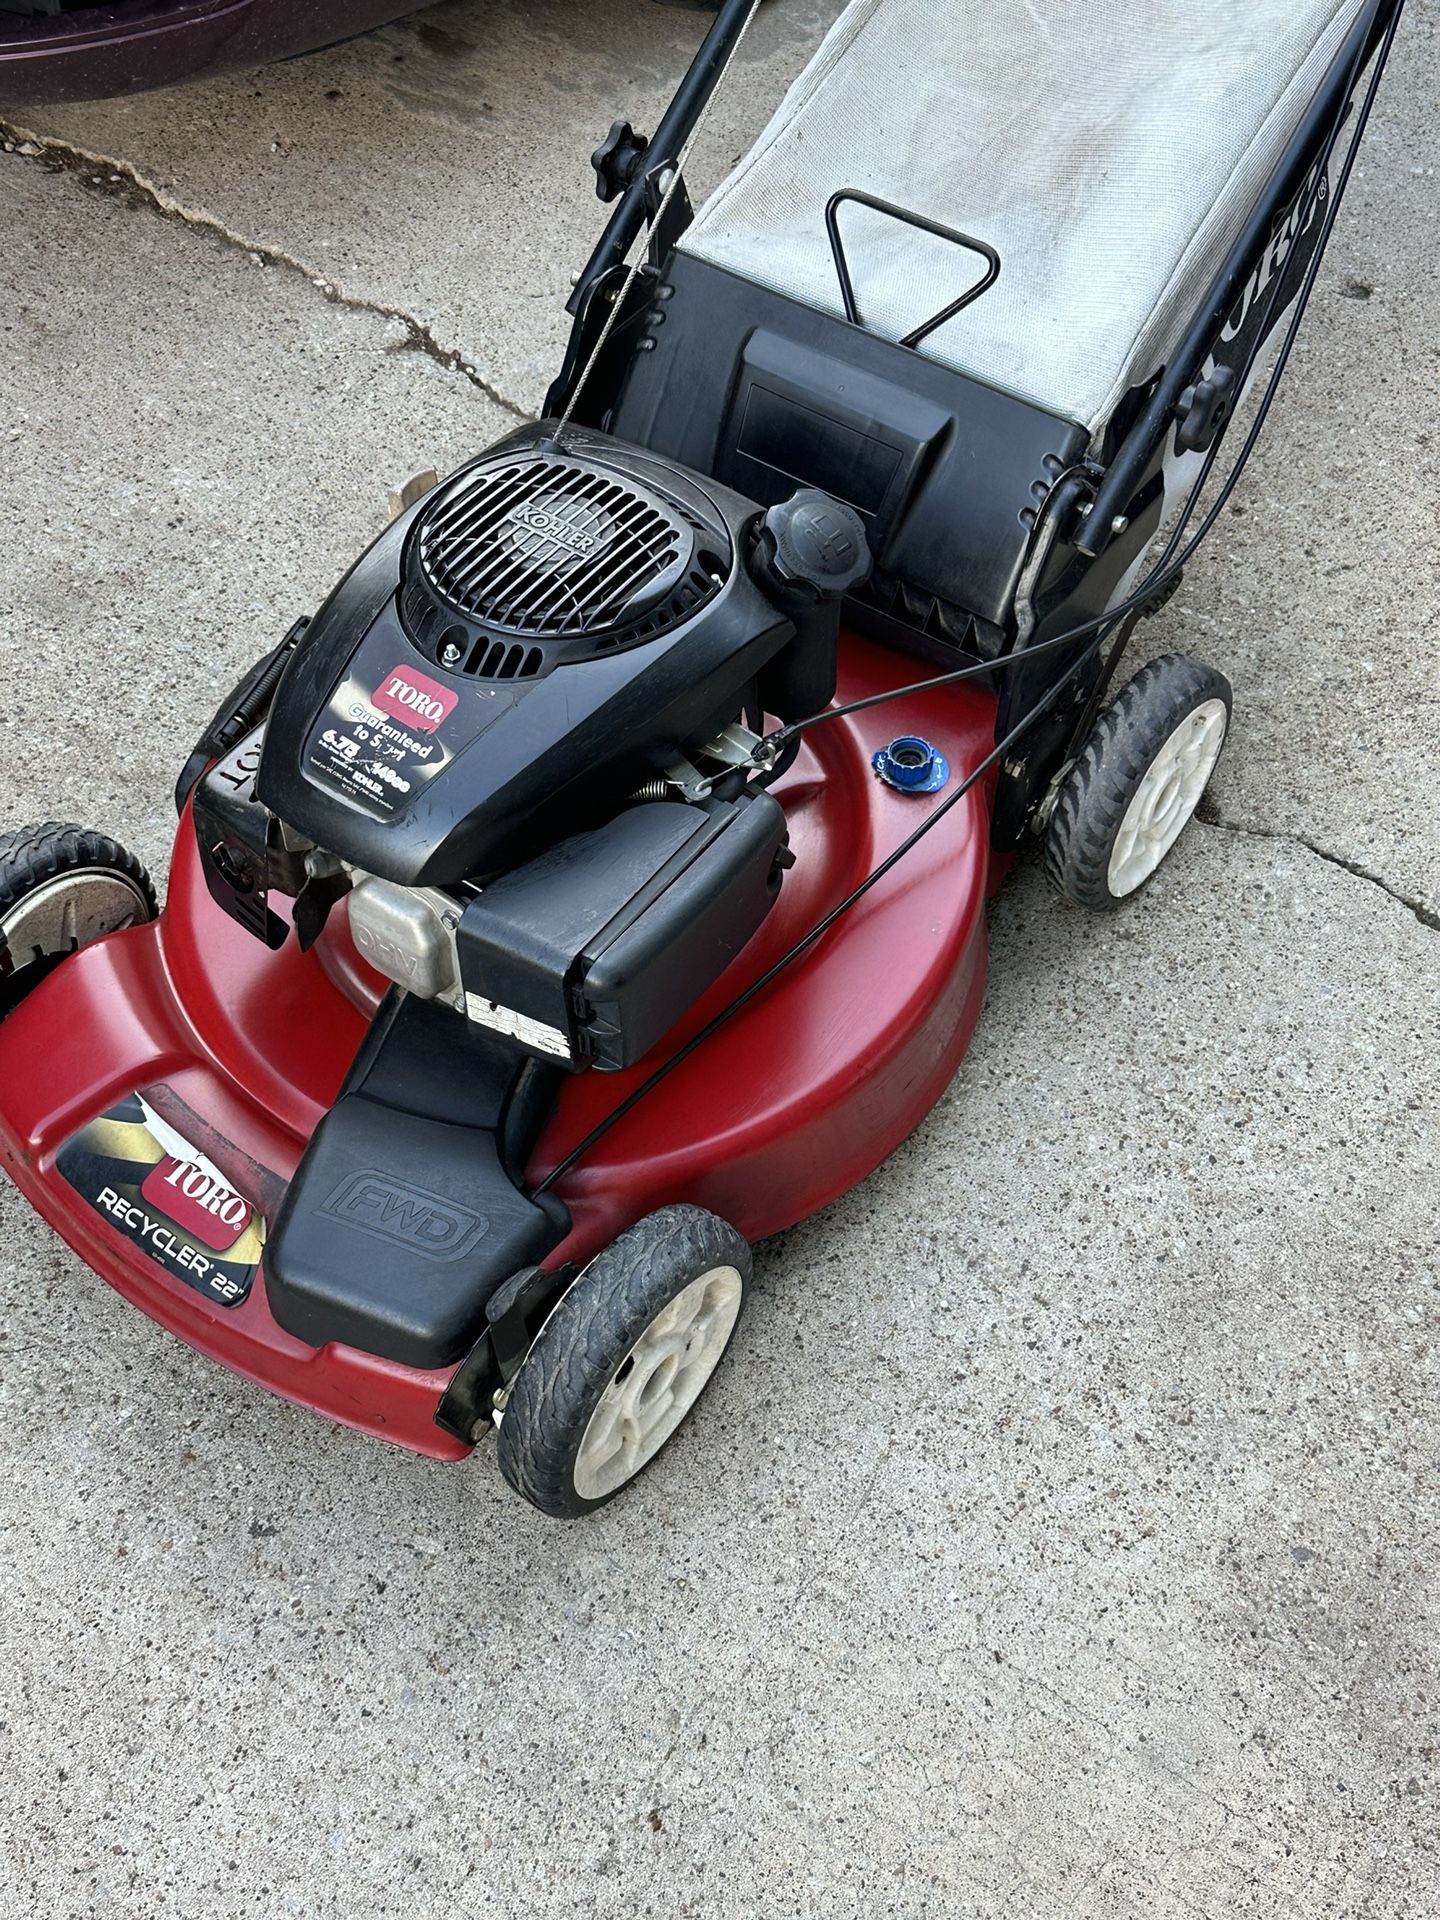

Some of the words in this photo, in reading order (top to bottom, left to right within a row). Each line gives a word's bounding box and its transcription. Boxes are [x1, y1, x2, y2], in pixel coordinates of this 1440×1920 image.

[515, 506, 595, 553] KOHLER
[348, 703, 434, 759] Guaranteed
[352, 725, 369, 740] to
[164, 1157, 248, 1227] TORO
[349, 1185, 458, 1242] FWD
[96, 1187, 212, 1279] RECYCLER
